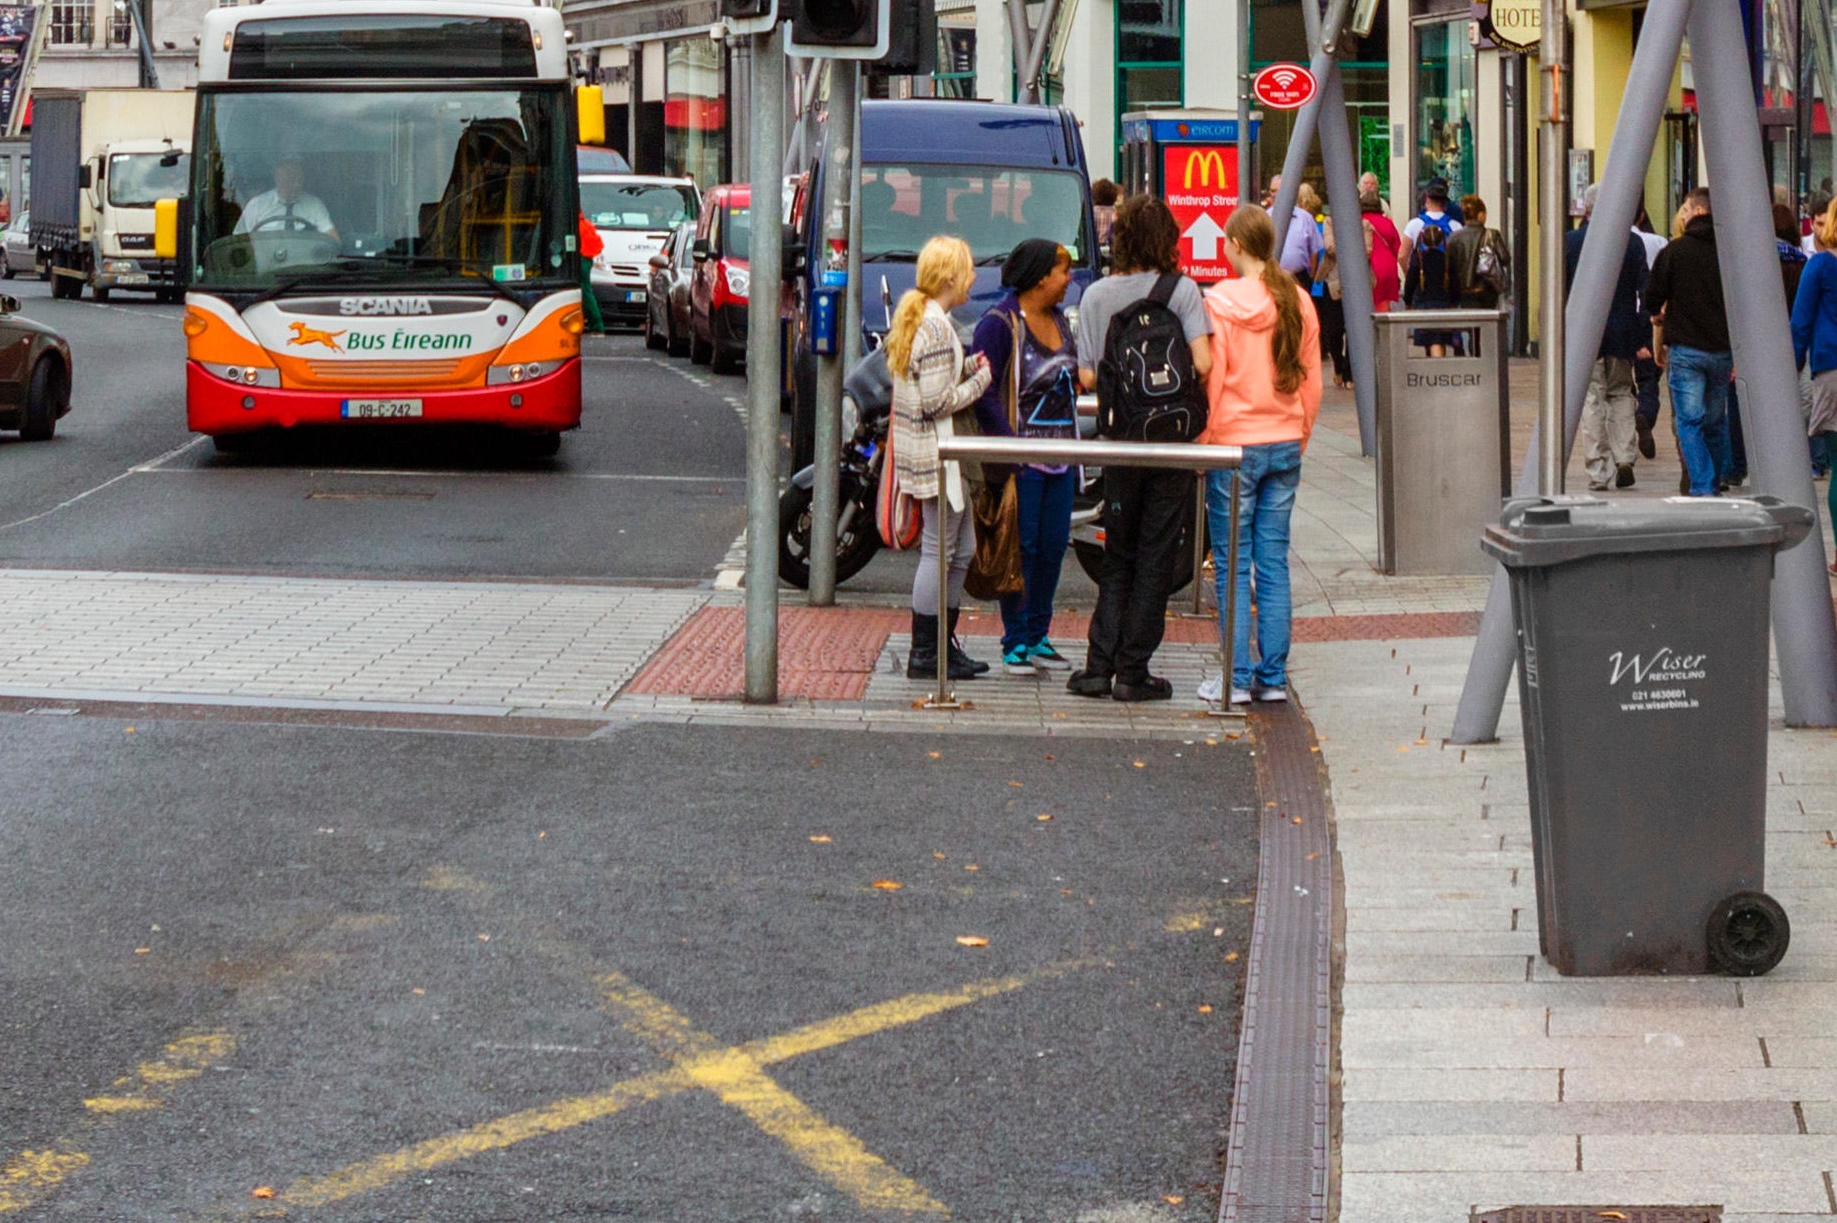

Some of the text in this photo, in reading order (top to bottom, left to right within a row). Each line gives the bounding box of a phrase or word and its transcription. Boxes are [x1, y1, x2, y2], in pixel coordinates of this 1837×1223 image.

[1496, 8, 1540, 28] HOTE
[1168, 195, 1210, 207] Winthrop
[1190, 266, 1228, 277] Minutes
[339, 298, 433, 315] SCANIA
[347, 331, 385, 349] Bus
[1407, 372, 1481, 387] Bruscar
[359, 404, 411, 417] 09-C-242
[1610, 647, 1706, 685] Wiser
[1649, 671, 1706, 681] RECYCLING
[1632, 690, 1648, 700] 021
[1620, 699, 1700, 711] www.wiserbins.ie
